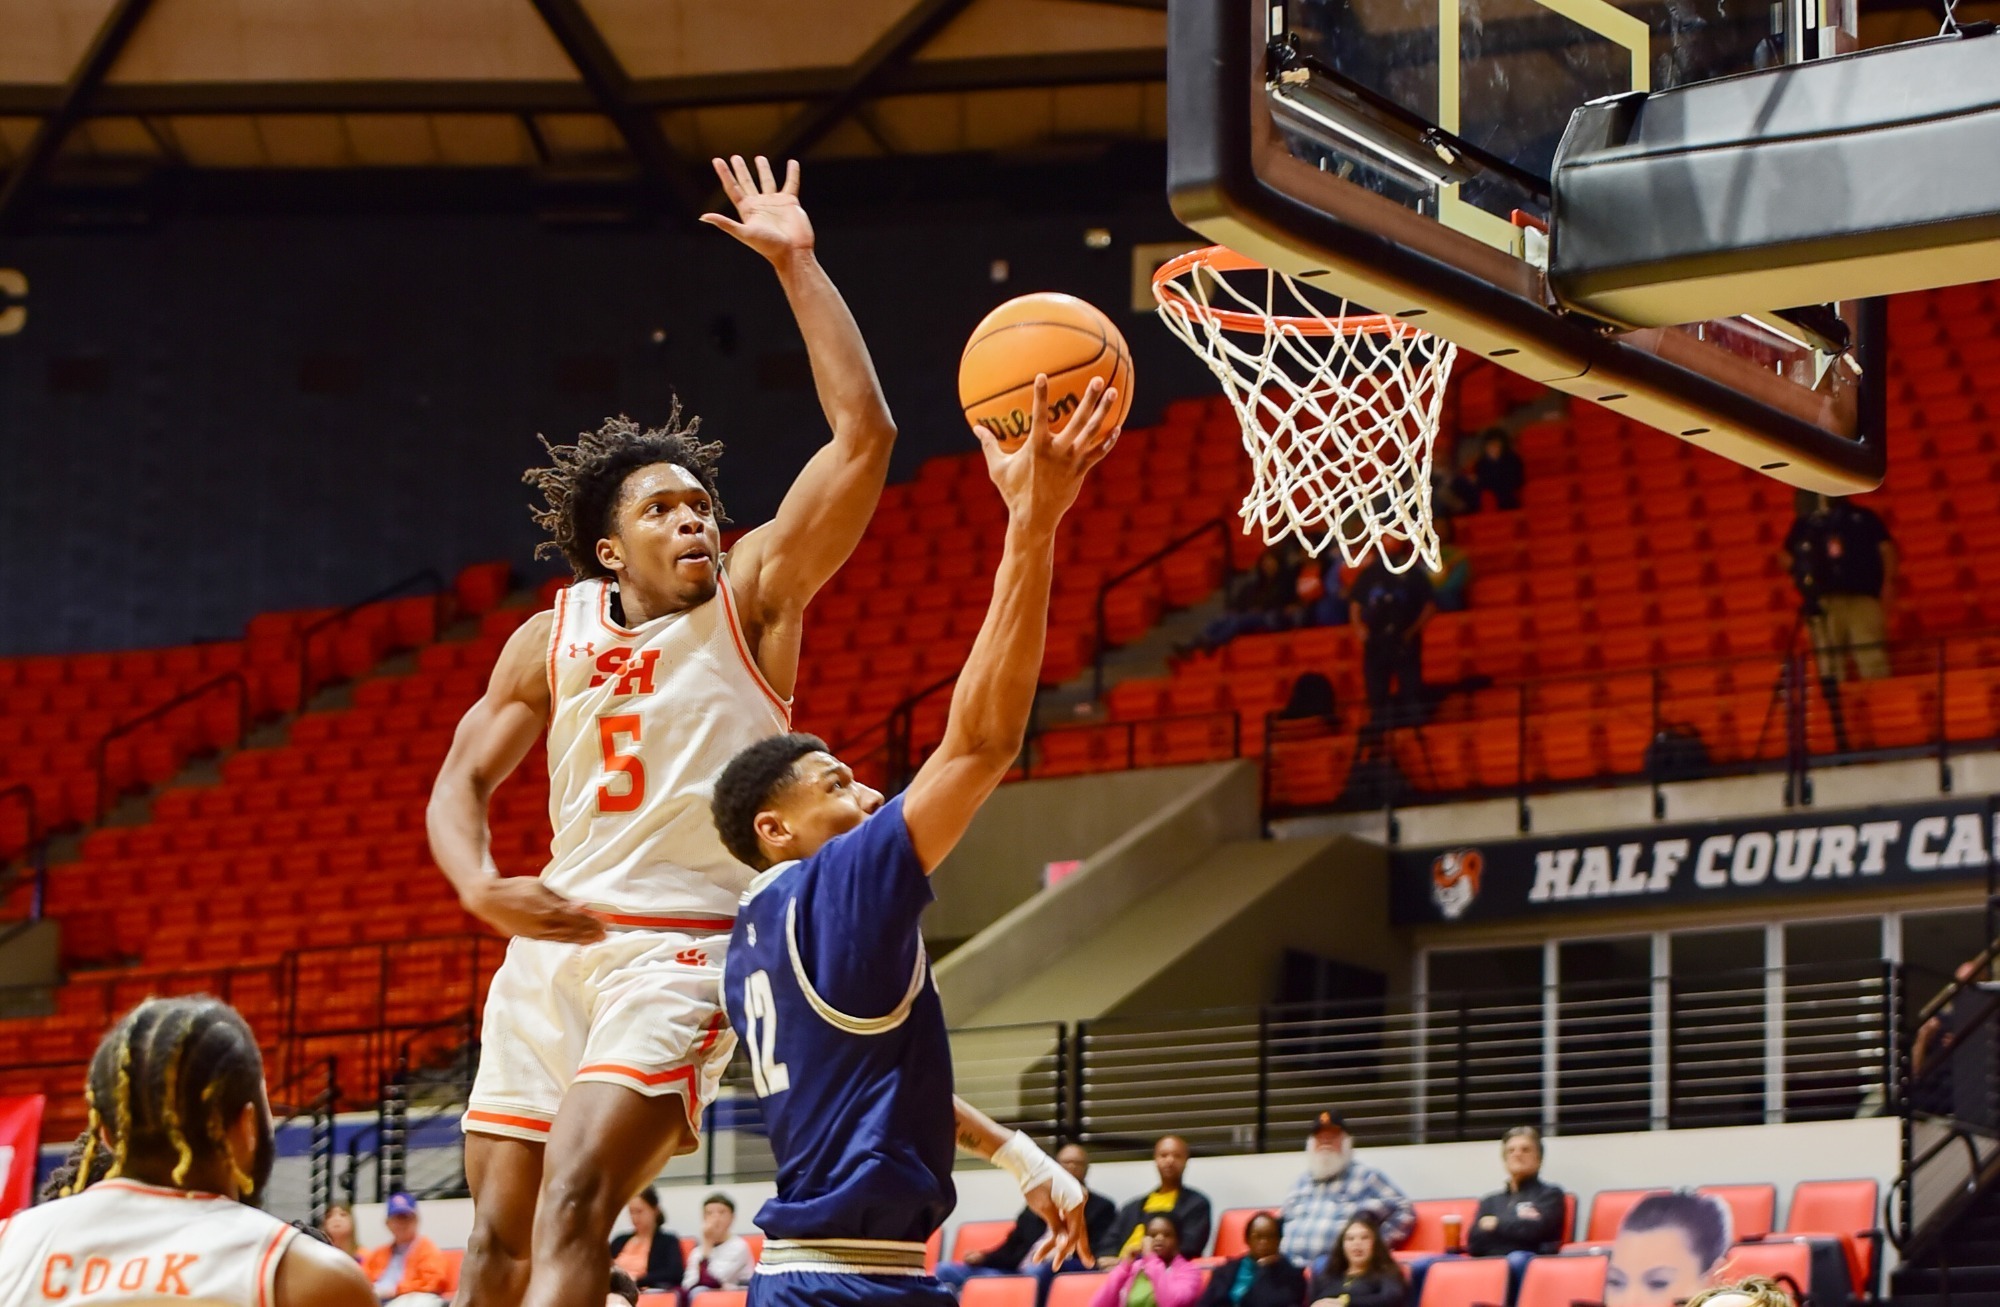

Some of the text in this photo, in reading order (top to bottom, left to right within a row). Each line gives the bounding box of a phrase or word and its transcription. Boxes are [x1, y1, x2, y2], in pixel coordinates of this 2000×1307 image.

[977, 393, 1080, 441] Wilon
[590, 647, 660, 696] SH
[596, 713, 647, 813] 5
[1530, 812, 2000, 902] HALF COURT CA
[744, 970, 789, 1097] 12
[42, 1254, 199, 1299] COOK
